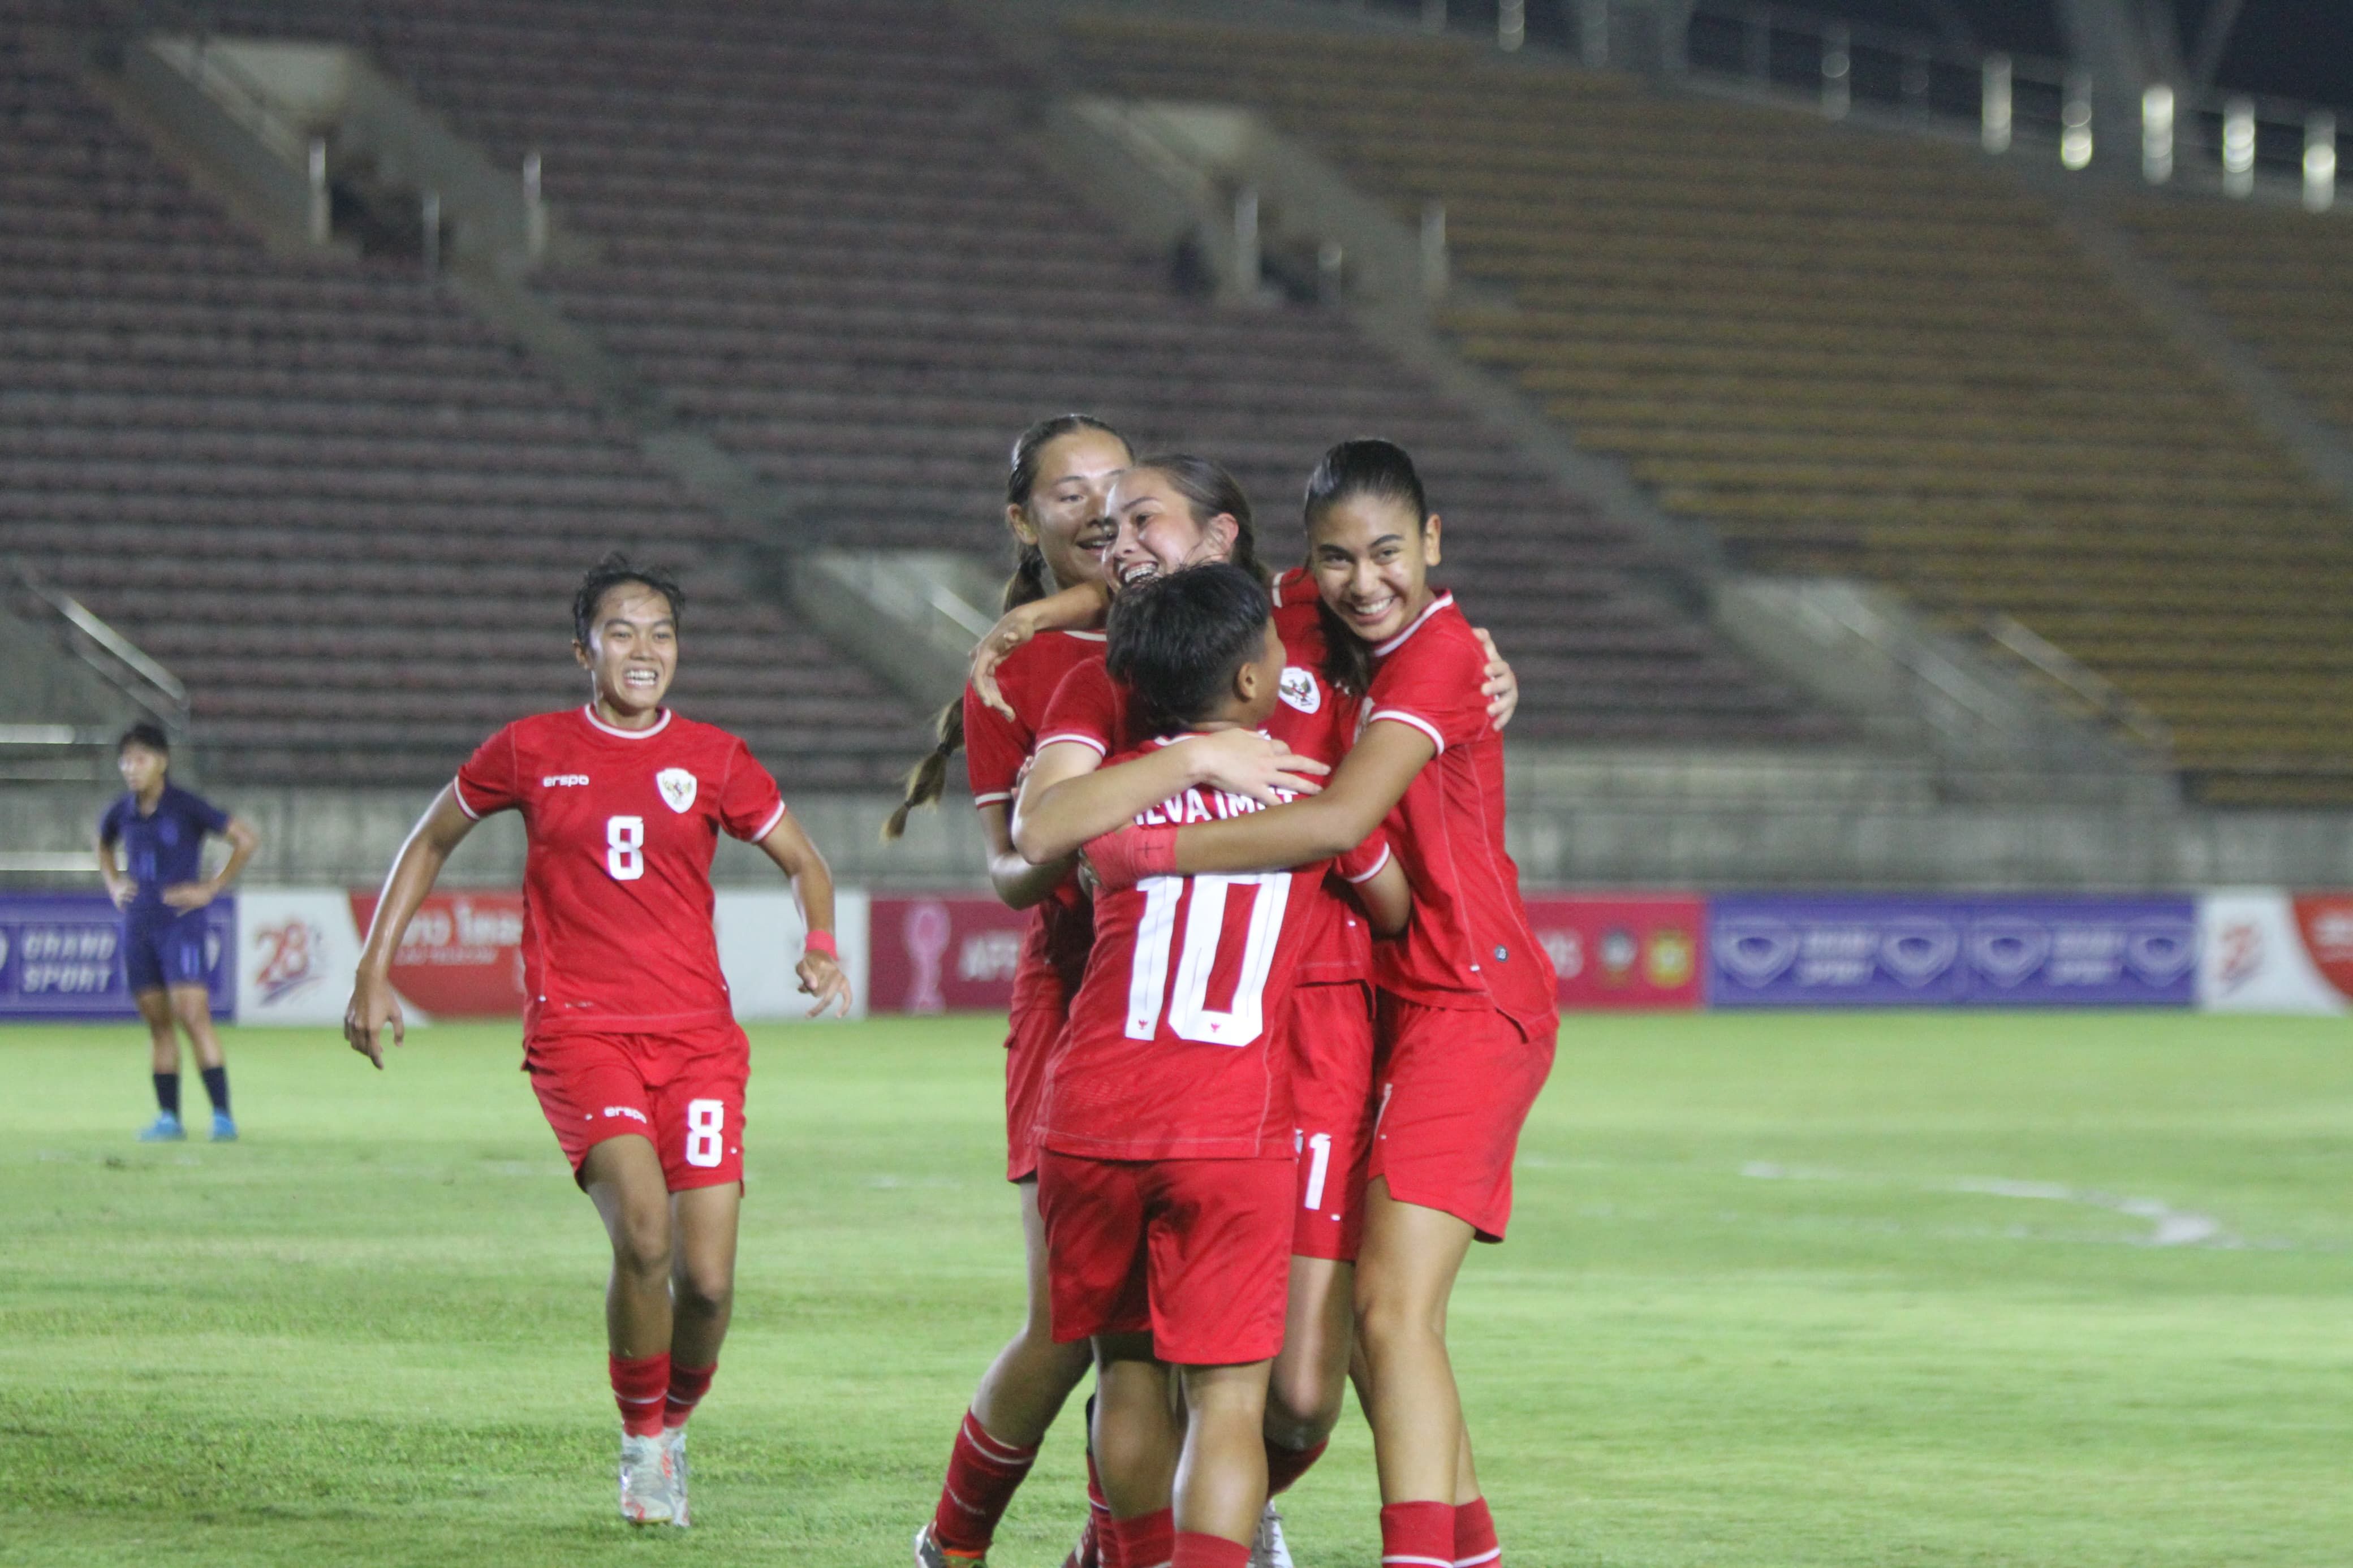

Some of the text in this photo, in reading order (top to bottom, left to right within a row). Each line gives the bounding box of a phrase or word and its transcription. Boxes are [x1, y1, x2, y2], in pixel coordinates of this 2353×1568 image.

[543, 774, 589, 788] erspo
[1135, 785, 1299, 826] EVA IMT
[607, 815, 644, 880] 8
[23, 932, 117, 961] GRAND
[1124, 872, 1292, 1047] 10
[24, 964, 111, 992] SPORT
[687, 1099, 724, 1168] 8
